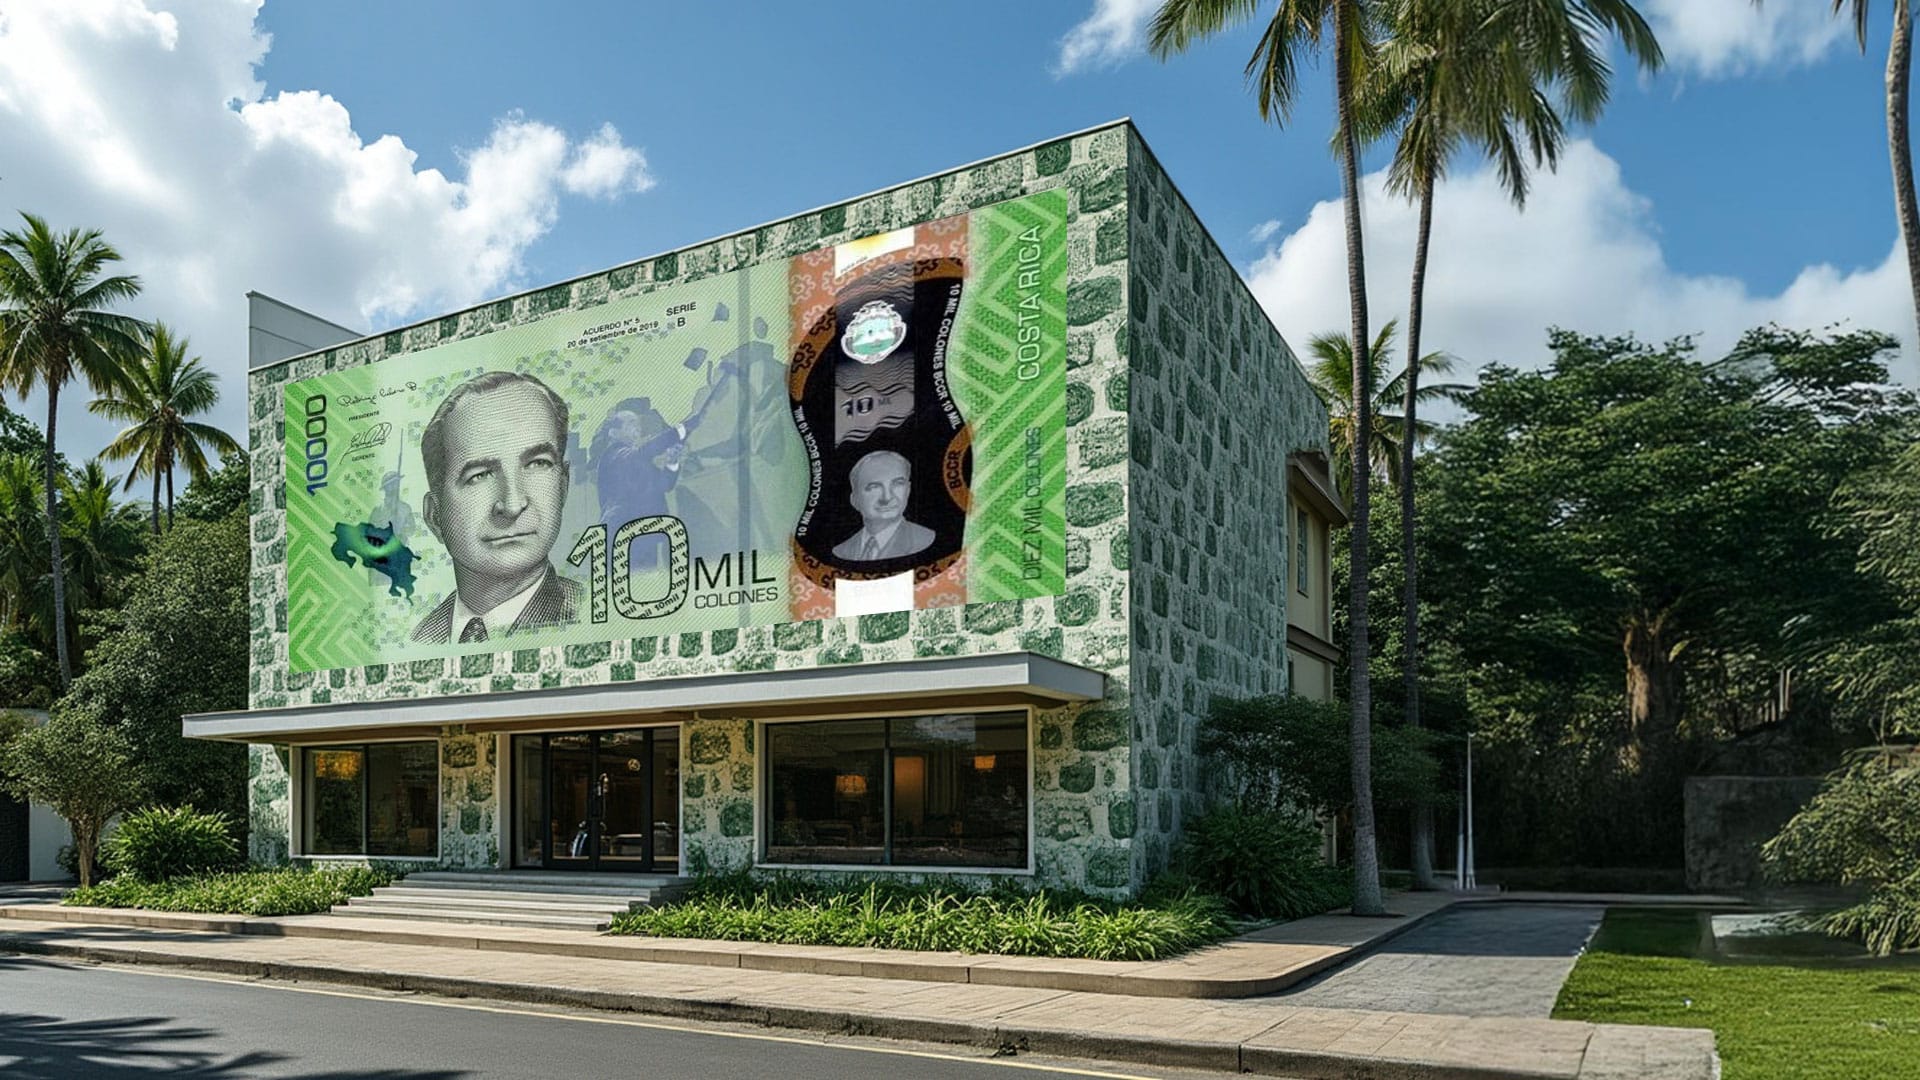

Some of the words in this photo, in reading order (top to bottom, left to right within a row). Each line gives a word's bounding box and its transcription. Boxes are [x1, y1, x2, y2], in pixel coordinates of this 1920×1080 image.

[1017, 225, 1041, 289] RICA
[950, 283, 960, 295] 10
[666, 302, 697, 316] SERIE
[944, 297, 958, 317] MIL
[583, 321, 621, 336] ACUERDO
[589, 329, 625, 343] setiembre
[628, 326, 637, 334] de
[639, 320, 659, 332] 2019
[677, 317, 686, 327] B
[933, 318, 953, 369] COLONES
[1017, 292, 1041, 381] COSTA
[932, 372, 948, 401] BCCR
[348, 410, 380, 421] PRESIDENTE
[942, 400, 953, 412] 10
[948, 411, 963, 430] MIL
[305, 394, 328, 496] 10000
[804, 432, 820, 459] BCCR
[946, 450, 962, 489] BCCR
[1025, 426, 1041, 498] COLONES
[808, 460, 822, 507] COLONES
[801, 509, 815, 526] MIL
[1022, 500, 1042, 534] MIL
[797, 527, 807, 537] 10
[567, 514, 690, 624] 10
[695, 549, 776, 591] MIL
[1023, 540, 1042, 580] DIEZ
[694, 587, 778, 609] COLONES
